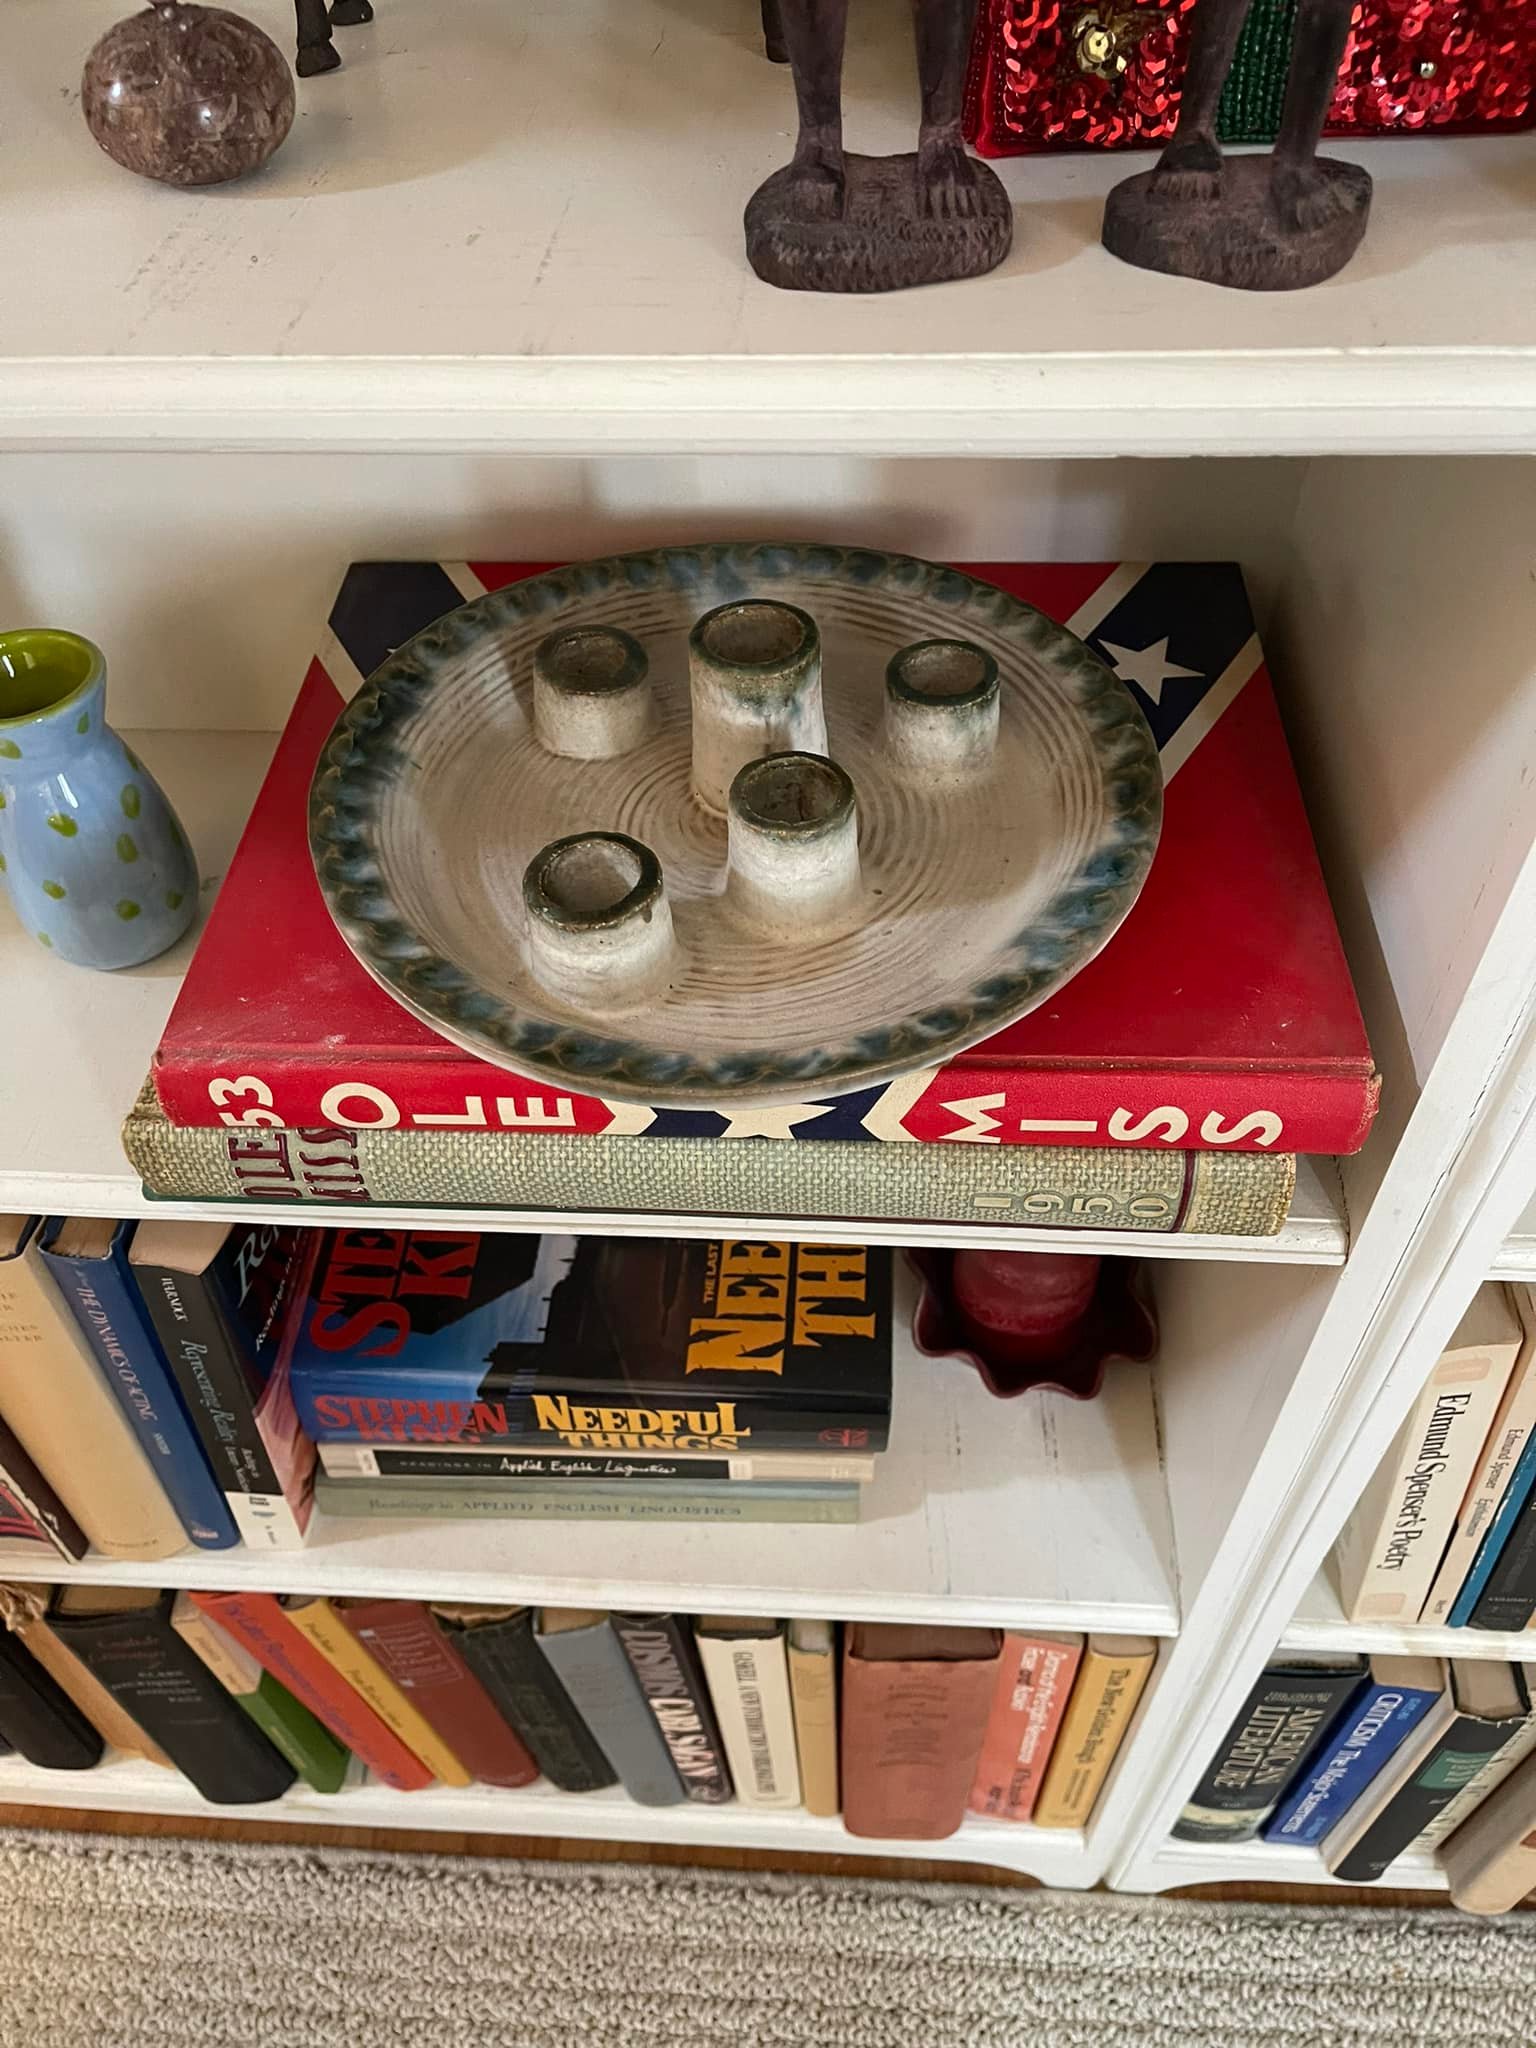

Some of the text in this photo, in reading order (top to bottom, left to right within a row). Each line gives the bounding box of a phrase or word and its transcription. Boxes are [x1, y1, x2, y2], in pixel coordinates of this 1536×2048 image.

[208, 1075, 284, 1129] 53
[320, 1081, 1284, 1148] OLE MISS
[973, 1190, 1169, 1219] 1950
[703, 1243, 719, 1304] THE LAST
[76, 1287, 102, 1310] THE
[88, 1308, 131, 1370] DYNAMICS
[118, 1367, 141, 1386] OF
[313, 1394, 509, 1434] STEPHEN
[531, 1395, 752, 1437] NEEDFUL
[1418, 1391, 1473, 1461] Edmund
[357, 1422, 482, 1444] KING
[559, 1432, 739, 1451] THINGS
[1497, 1428, 1525, 1461] Edmund
[499, 1457, 545, 1473] Applied
[1486, 1461, 1511, 1489] Spenser
[463, 1501, 534, 1511] APPLIED
[543, 1502, 620, 1514] ENGLISH
[627, 1505, 742, 1516] LINGUISTICS
[1395, 1461, 1447, 1528] Spenser's
[1376, 1526, 1424, 1571] Poetry
[650, 1698, 703, 1732] CARL
[1344, 1693, 1404, 1748] CRITICISM
[1213, 1704, 1292, 1789] LITERATURE
[1251, 1706, 1325, 1785] AMERICAN
[1329, 1748, 1363, 1771] The
[1312, 1767, 1348, 1793] Major
